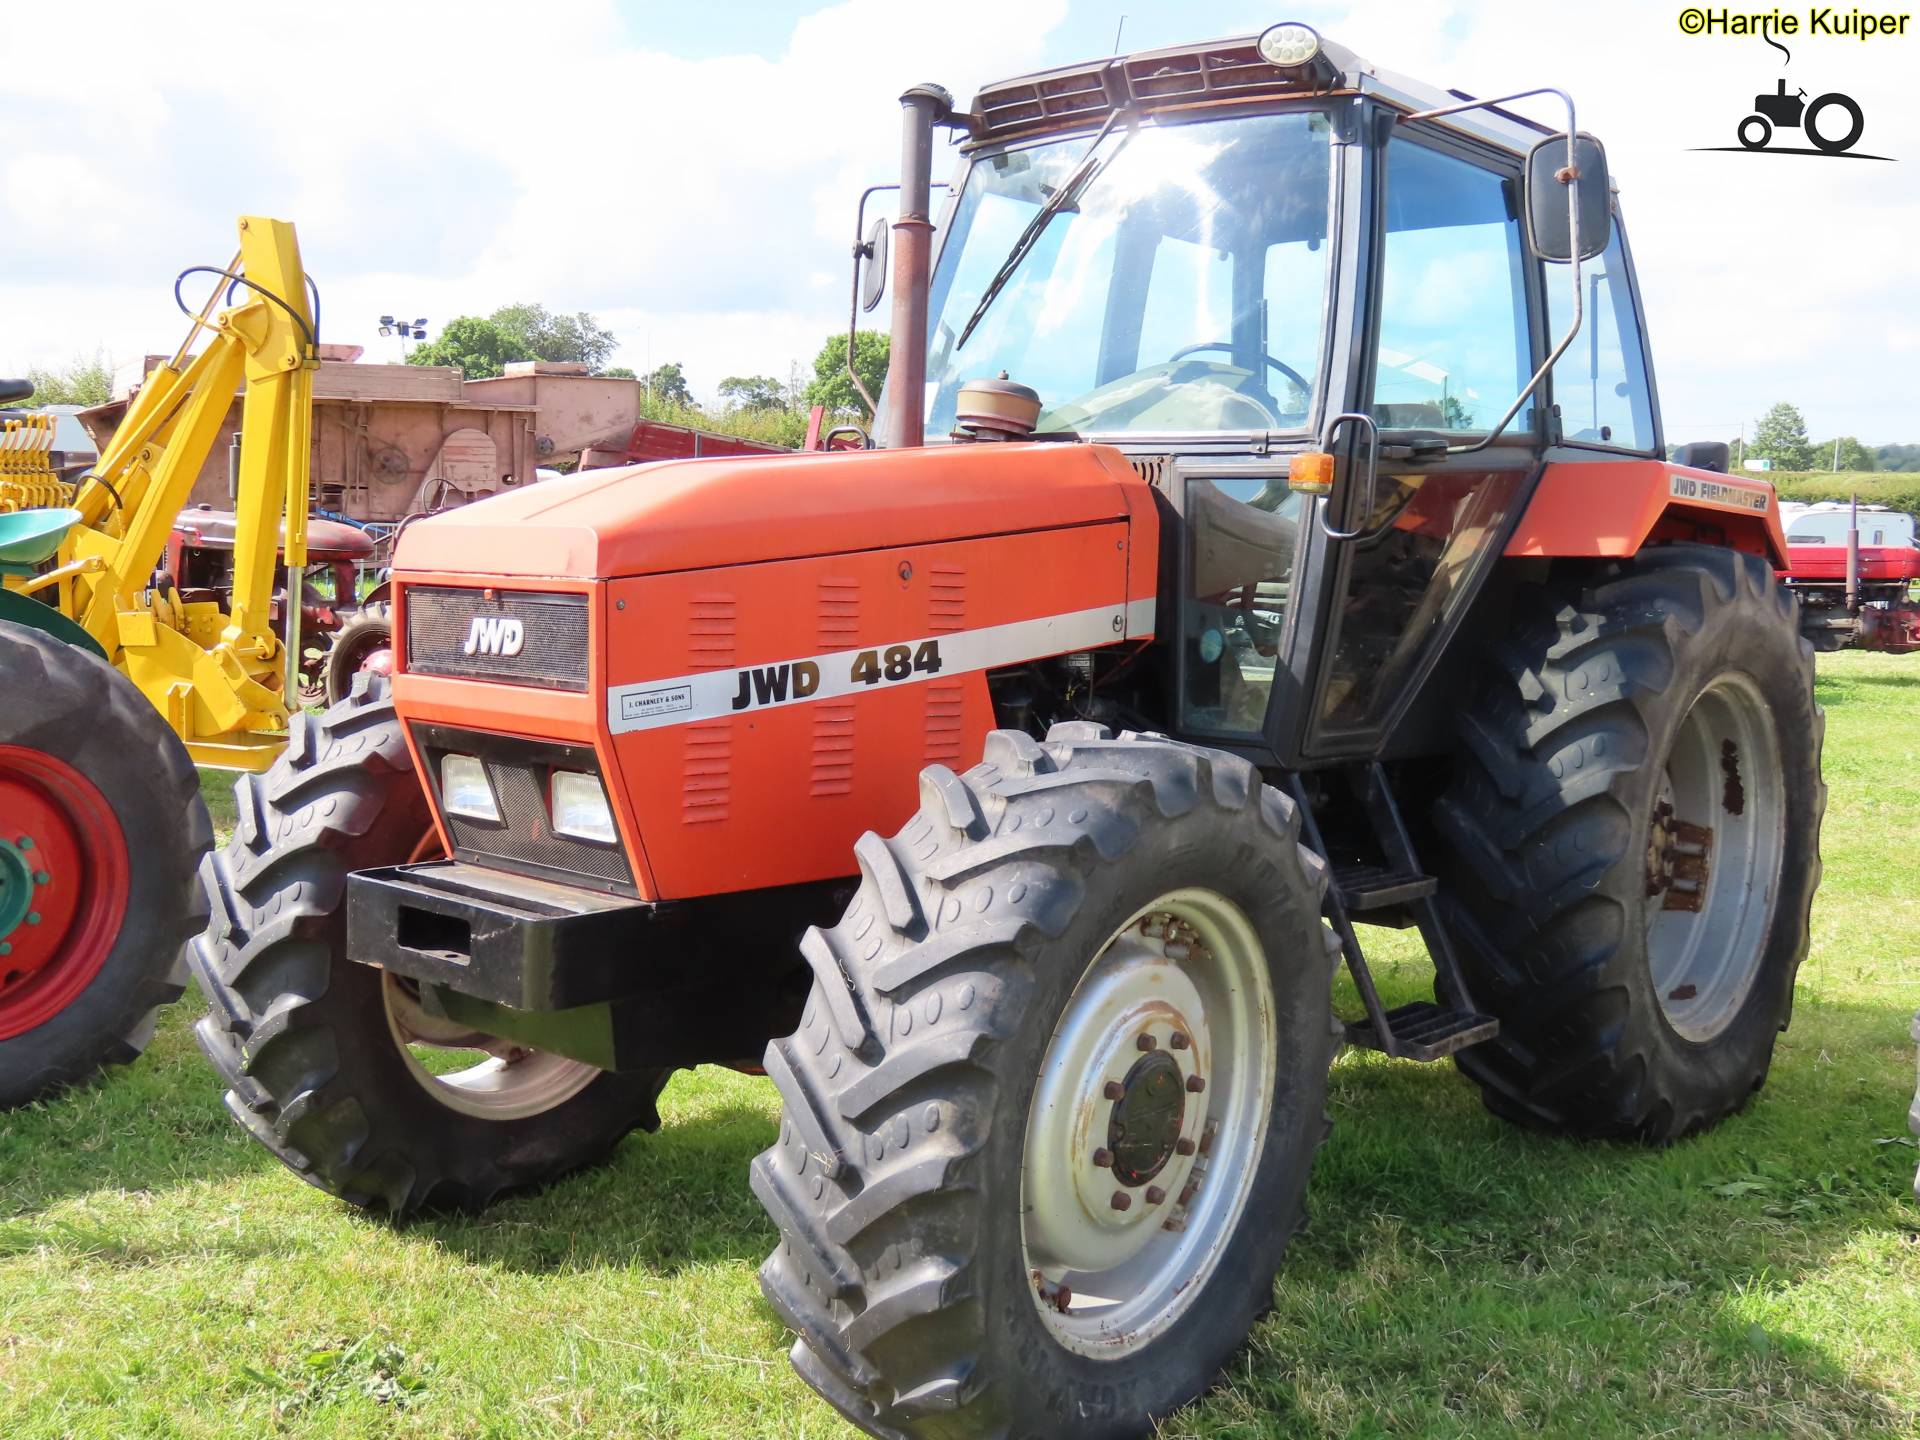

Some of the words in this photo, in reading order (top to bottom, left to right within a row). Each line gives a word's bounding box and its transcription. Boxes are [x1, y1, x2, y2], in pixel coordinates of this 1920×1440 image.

[1673, 477, 1697, 497] JWD
[1700, 483, 1767, 509] FIELDMASTER
[464, 617, 525, 657] JWD
[731, 660, 820, 711] JWD
[850, 640, 942, 685] 484
[634, 697, 664, 707] CHARNLEY
[671, 693, 685, 702] SONS
